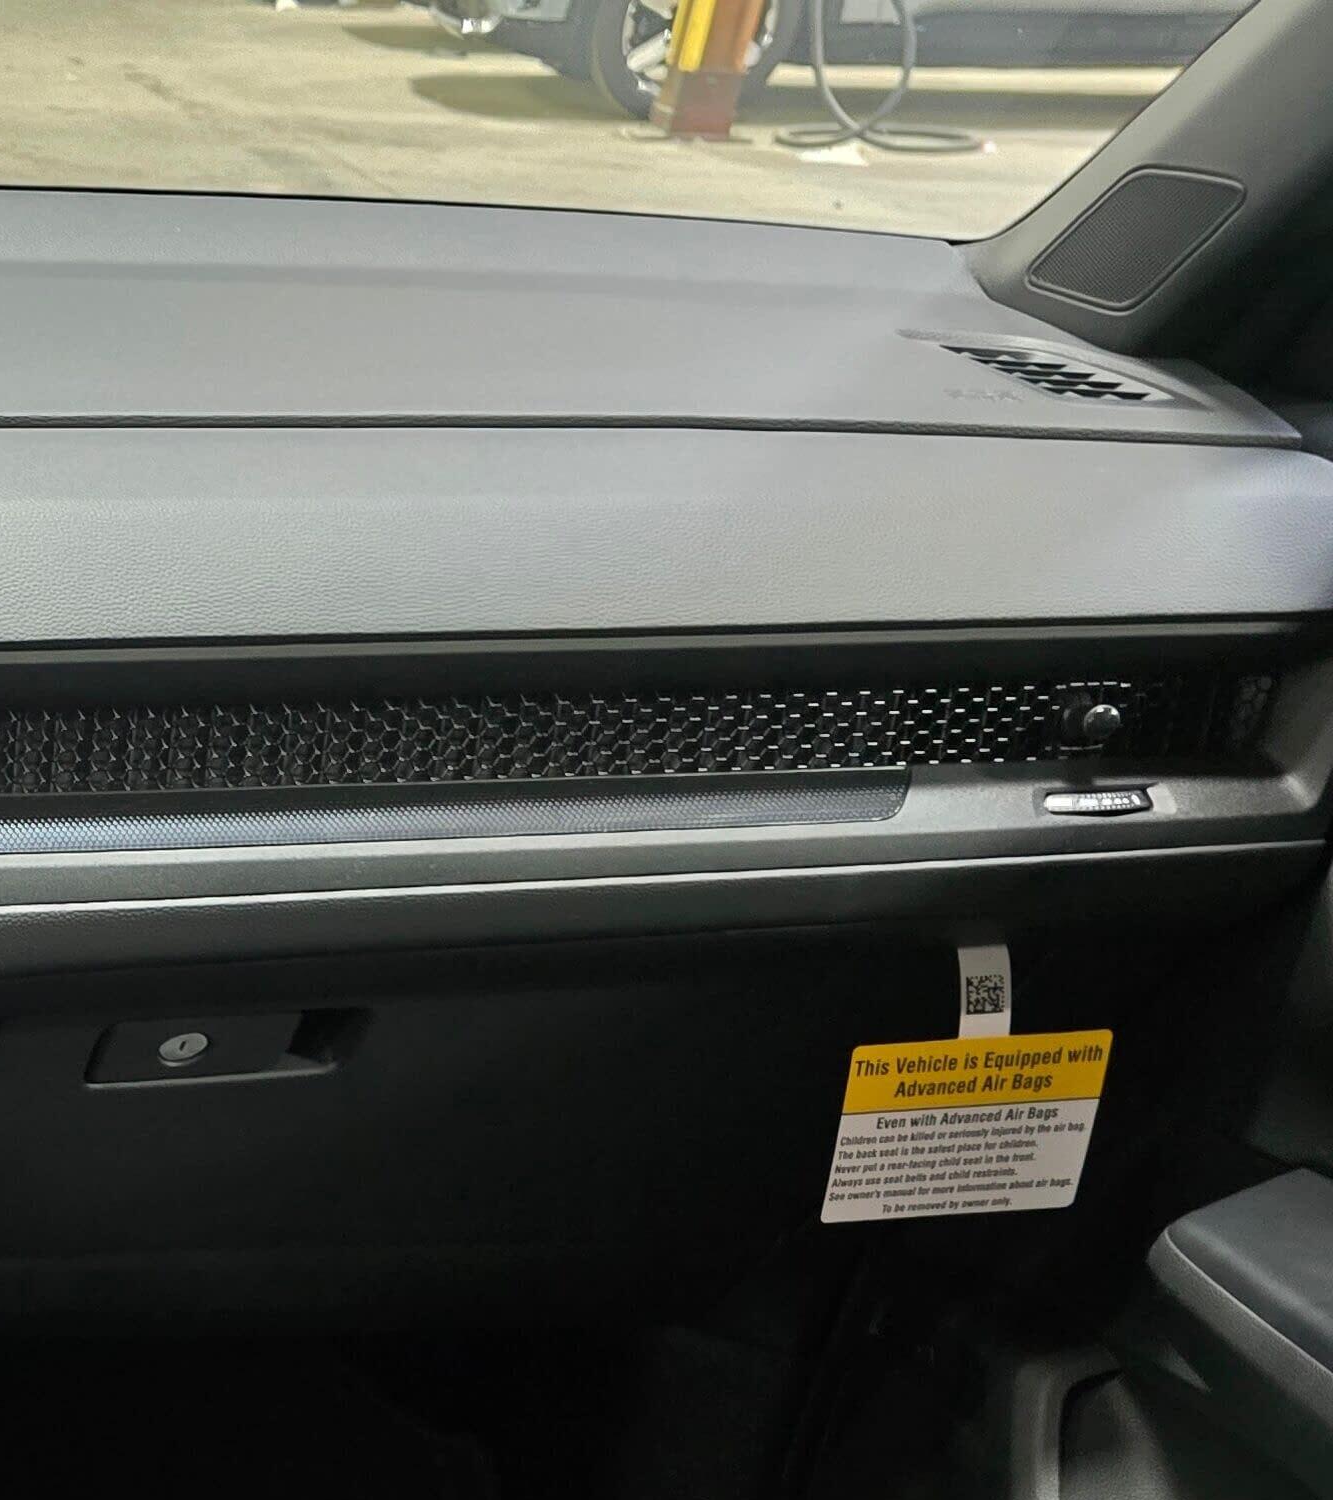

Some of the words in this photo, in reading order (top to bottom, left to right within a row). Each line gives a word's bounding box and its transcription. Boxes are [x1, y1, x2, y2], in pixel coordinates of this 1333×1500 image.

[855, 1059, 890, 1077] This
[895, 1054, 958, 1074] Vehicle
[964, 1053, 979, 1070] is
[984, 1047, 1063, 1071] Equipped
[1067, 1044, 1103, 1063] with
[894, 1076, 978, 1098] Advanced
[981, 1074, 1008, 1092] Air
[1012, 1073, 1053, 1093] Bags
[876, 1116, 906, 1129] Even
[909, 1114, 937, 1127] with
[939, 1110, 1002, 1125] Advanced
[1004, 1108, 1024, 1120] Air
[1027, 1107, 1059, 1120] Bags
[840, 1135, 877, 1146] Children
[879, 1135, 895, 1144] can
[897, 1134, 908, 1142] be
[910, 1131, 936, 1141] killed
[937, 1131, 947, 1139] or
[948, 1127, 989, 1138] seriously
[990, 1125, 1023, 1137] injured
[1024, 1124, 1035, 1135] by
[1037, 1123, 1051, 1133] the
[1053, 1123, 1066, 1132] air
[838, 1151, 853, 1160] The
[856, 1149, 877, 1159] back
[879, 1147, 899, 1157] seat
[901, 1147, 909, 1156] is
[911, 1146, 926, 1155] the
[956, 1143, 982, 1153] place
[834, 1164, 861, 1174] Never
[862, 1163, 878, 1173] put
[887, 1159, 937, 1169] rear-facing
[938, 1157, 962, 1167] child
[962, 1156, 983, 1166] seat
[831, 1178, 863, 1188] Always
[864, 1177, 881, 1186] use
[883, 1174, 904, 1184] seat
[929, 1171, 947, 1181] and
[948, 1170, 971, 1179] child
[829, 1192, 845, 1201] See
[847, 1190, 881, 1200] owner's
[883, 1187, 916, 1198] manual
[931, 1185, 955, 1194] more
[882, 1204, 892, 1213] To
[893, 1203, 905, 1212] be
[908, 1201, 947, 1211] removed
[949, 1200, 959, 1210] by
